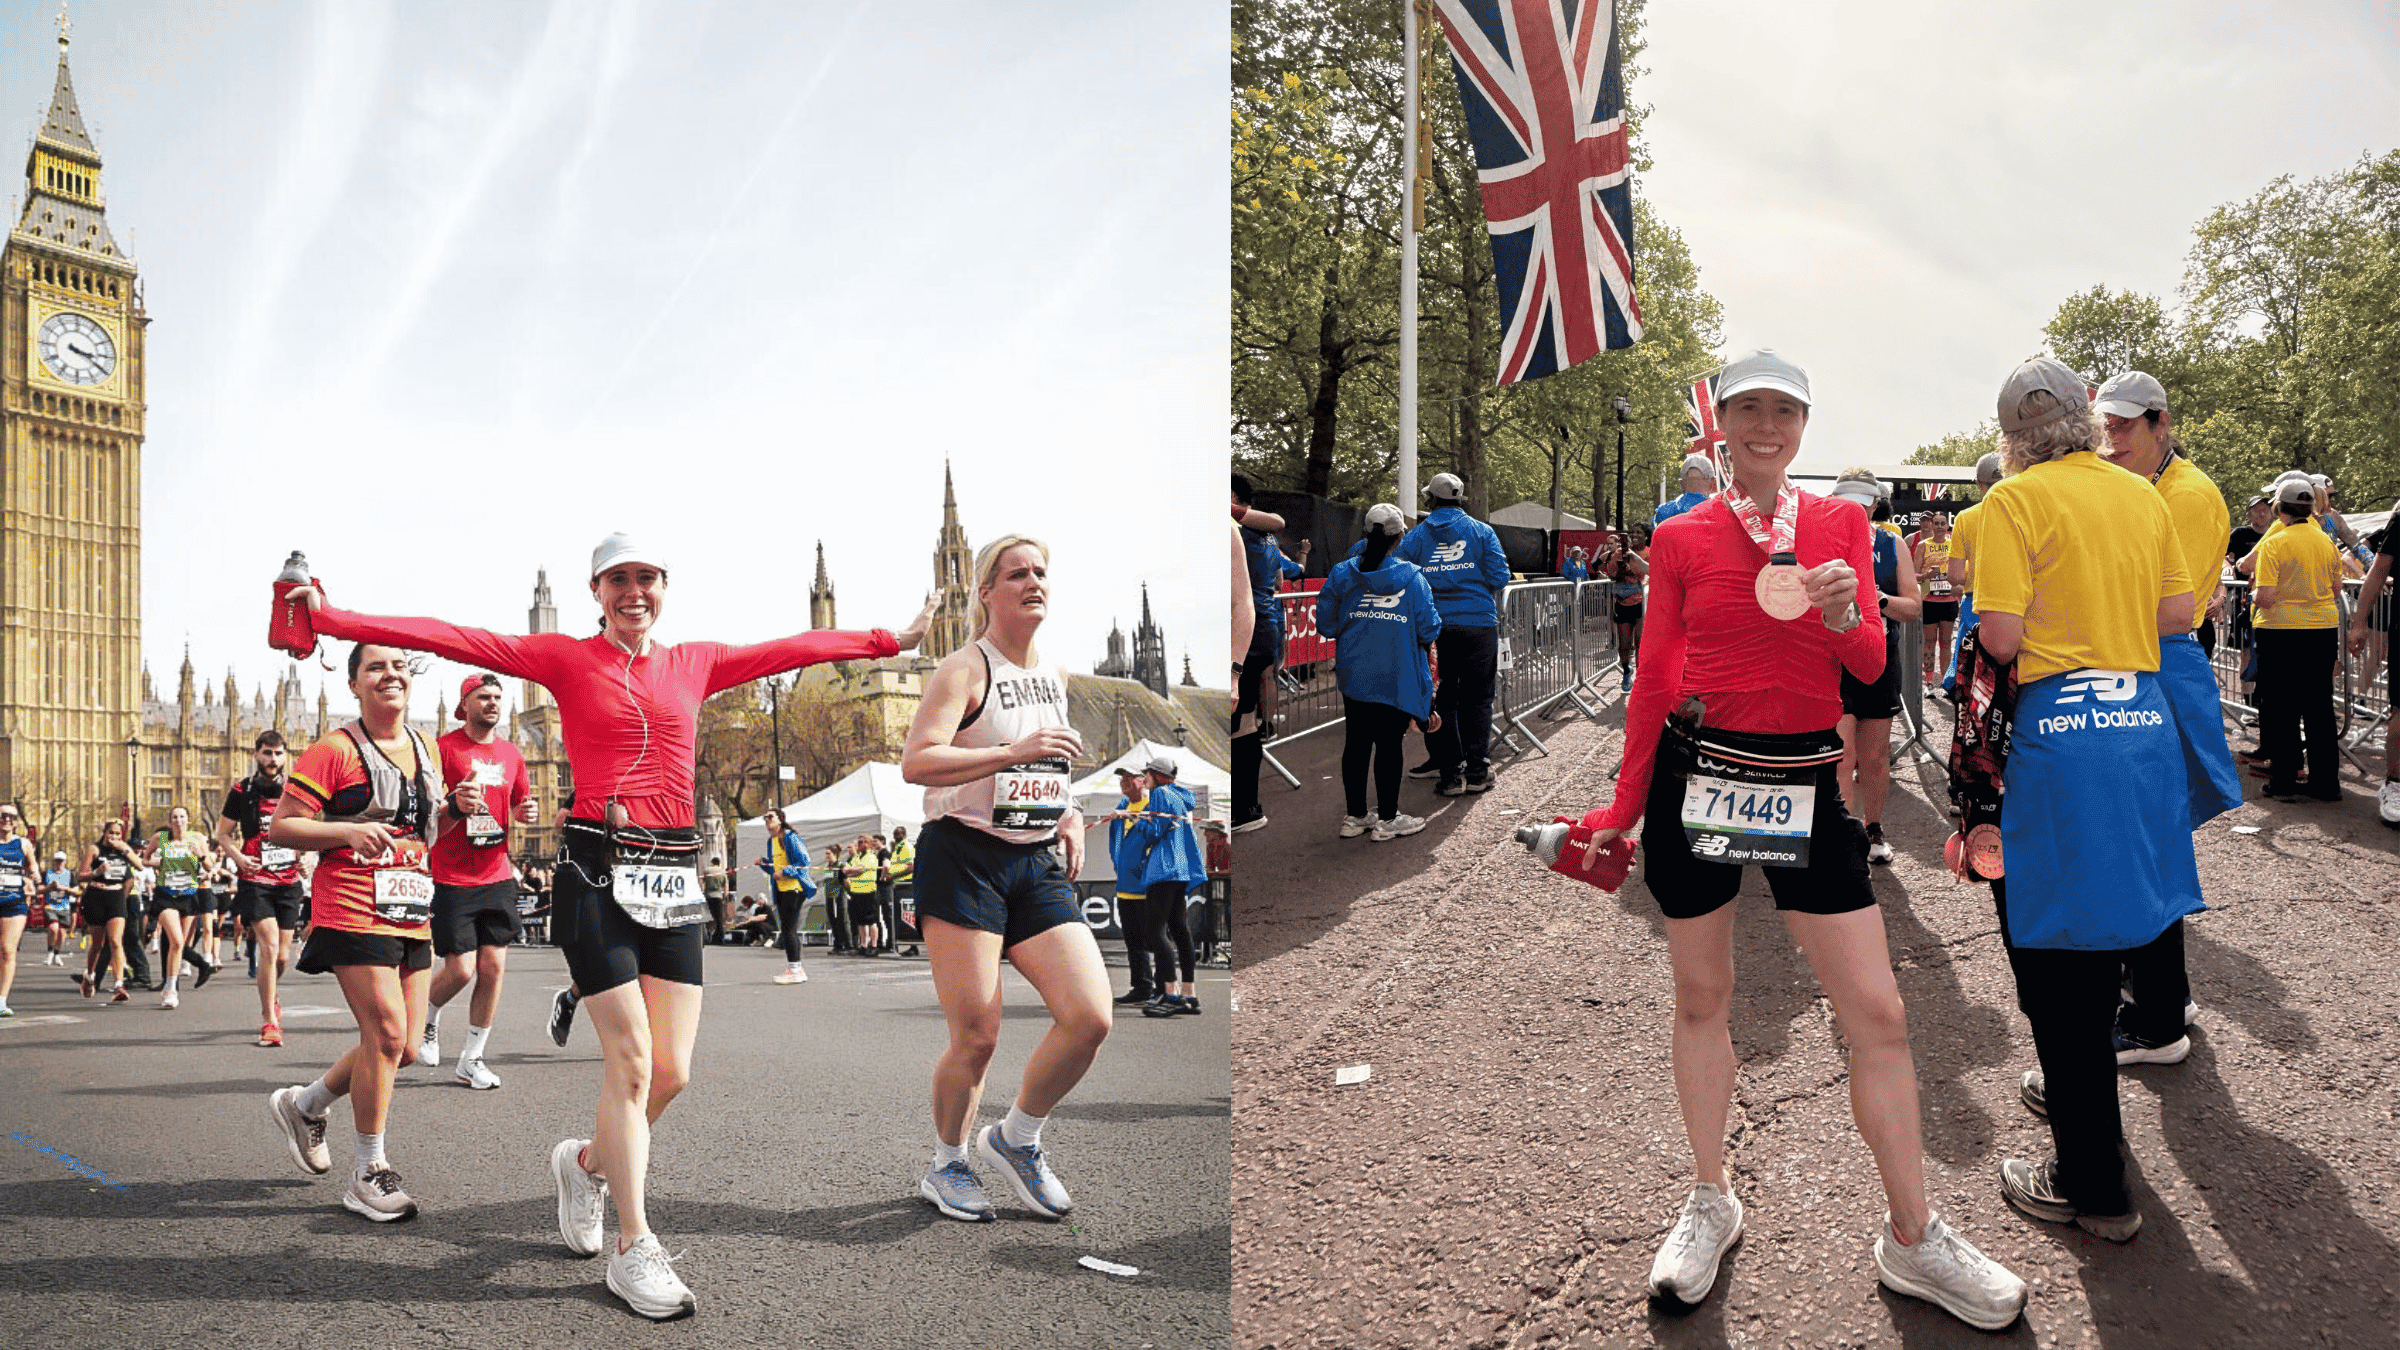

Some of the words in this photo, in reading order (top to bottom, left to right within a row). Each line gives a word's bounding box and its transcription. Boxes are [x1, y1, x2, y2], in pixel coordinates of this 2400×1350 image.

[1440, 562, 1475, 572] balance
[1349, 610, 1369, 618] new
[1369, 609, 1408, 623] balance
[996, 677, 1063, 710] EMMA
[2038, 712, 2088, 734] new
[2091, 706, 2163, 729] balance
[1008, 779, 1060, 801] 24640
[1705, 787, 1793, 825] 71449
[1570, 839, 1611, 856] NATAN
[1728, 849, 1750, 859] new
[1752, 849, 1797, 861] balance
